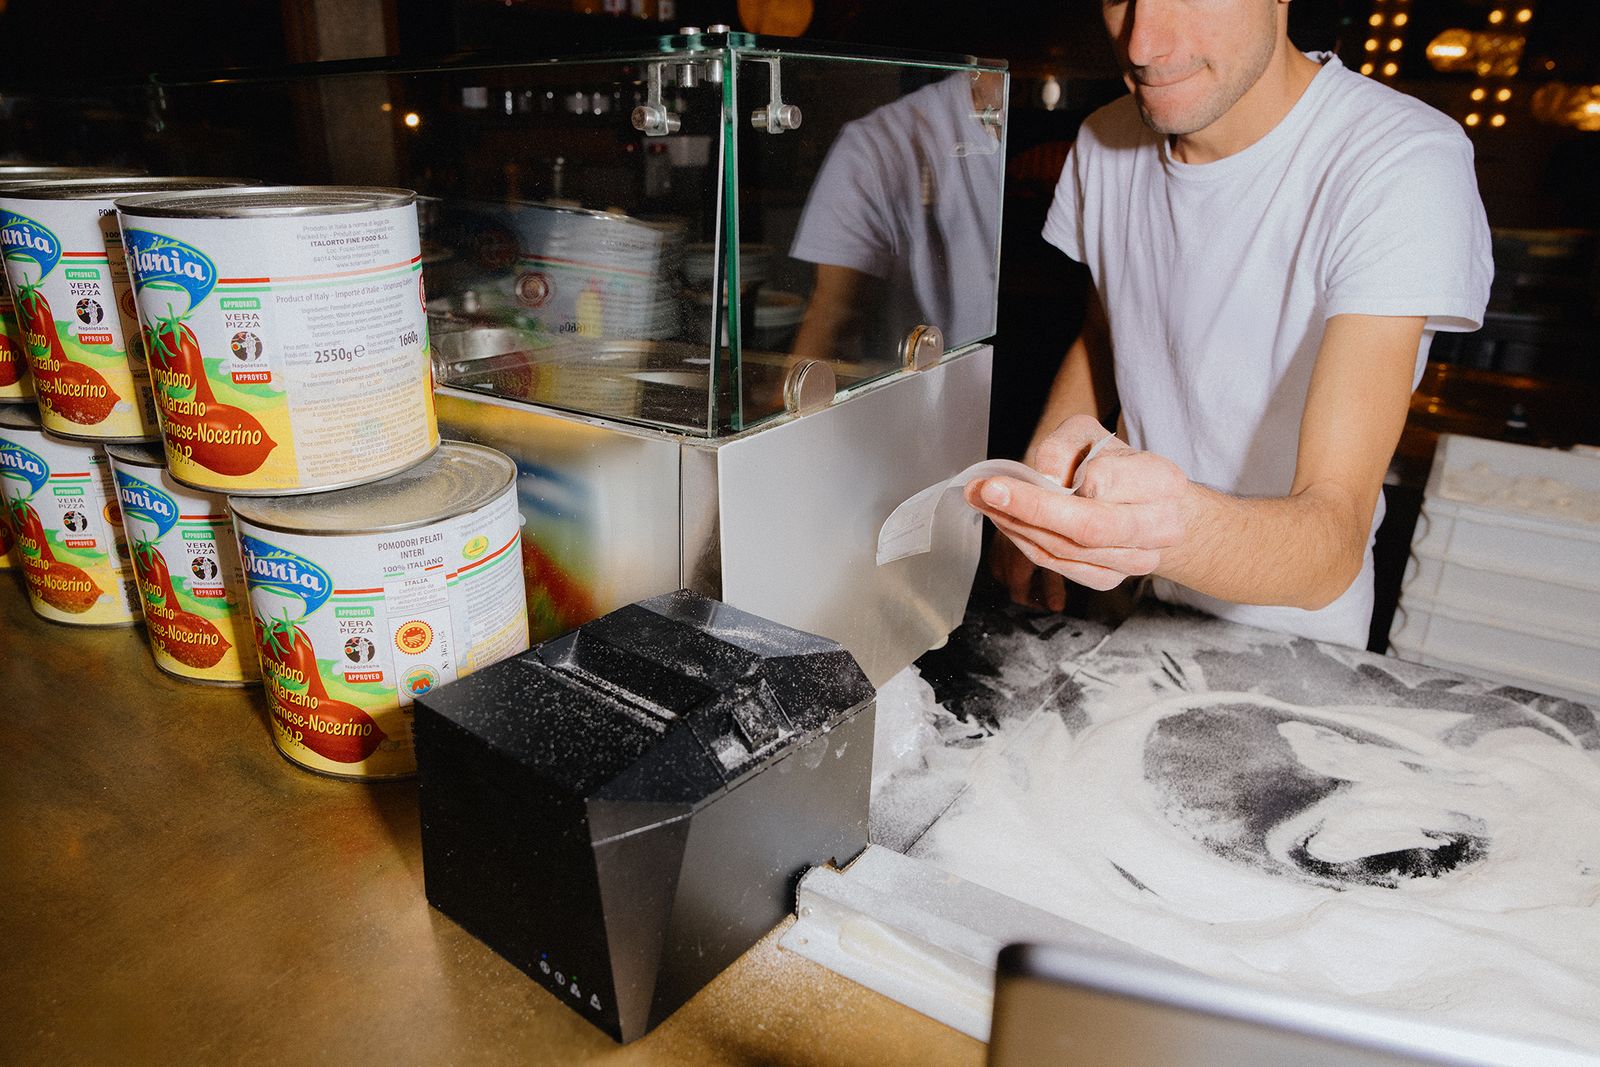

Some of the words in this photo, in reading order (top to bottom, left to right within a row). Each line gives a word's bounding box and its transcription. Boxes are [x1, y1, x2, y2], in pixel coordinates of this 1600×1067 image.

[310, 238, 345, 248] ITALORTO
[346, 236, 360, 245] FINE
[361, 235, 376, 243] FOOD
[276, 295, 304, 303] Product
[306, 293, 313, 301] of
[314, 292, 330, 302] Italy
[223, 299, 257, 308] APPROVATO
[224, 313, 260, 321] VERA
[314, 347, 353, 364] 2550g
[398, 330, 419, 347] 1660g
[235, 373, 269, 381] APPROVED
[377, 537, 419, 552] POMODORI
[419, 532, 444, 545] PELATI
[400, 547, 425, 560] INTERI
[383, 564, 405, 573] 100%
[406, 556, 444, 570] ITALIANO
[404, 577, 429, 587] ITALIA
[337, 607, 371, 616] APPROVATO
[339, 620, 373, 628] VERA
[347, 673, 380, 681] APPROVED
